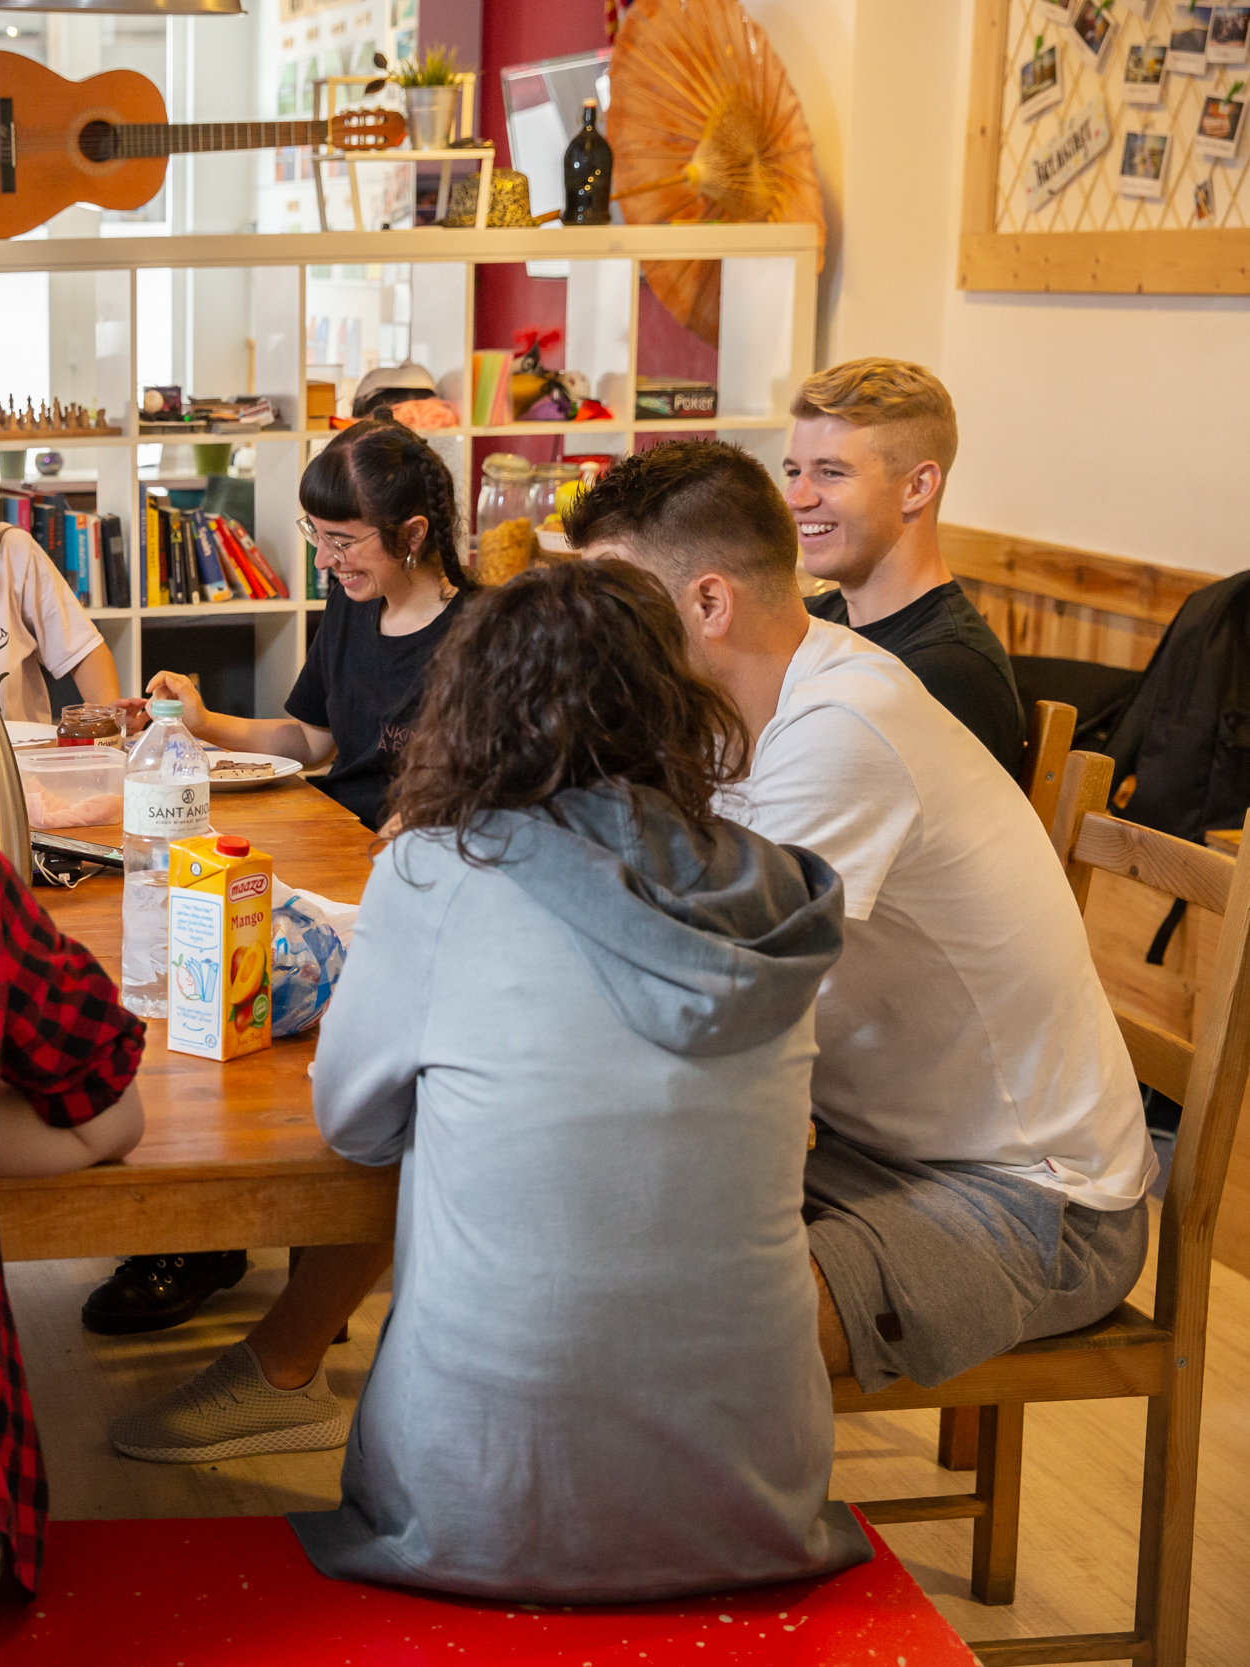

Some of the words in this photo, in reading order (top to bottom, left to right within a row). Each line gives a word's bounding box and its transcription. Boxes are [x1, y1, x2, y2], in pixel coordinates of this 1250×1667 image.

[674, 393, 715, 411] Poker
[148, 806, 184, 818] SANT
[186, 802, 210, 818] ANIO
[231, 878, 266, 896] maaza
[231, 911, 264, 931] Mango
